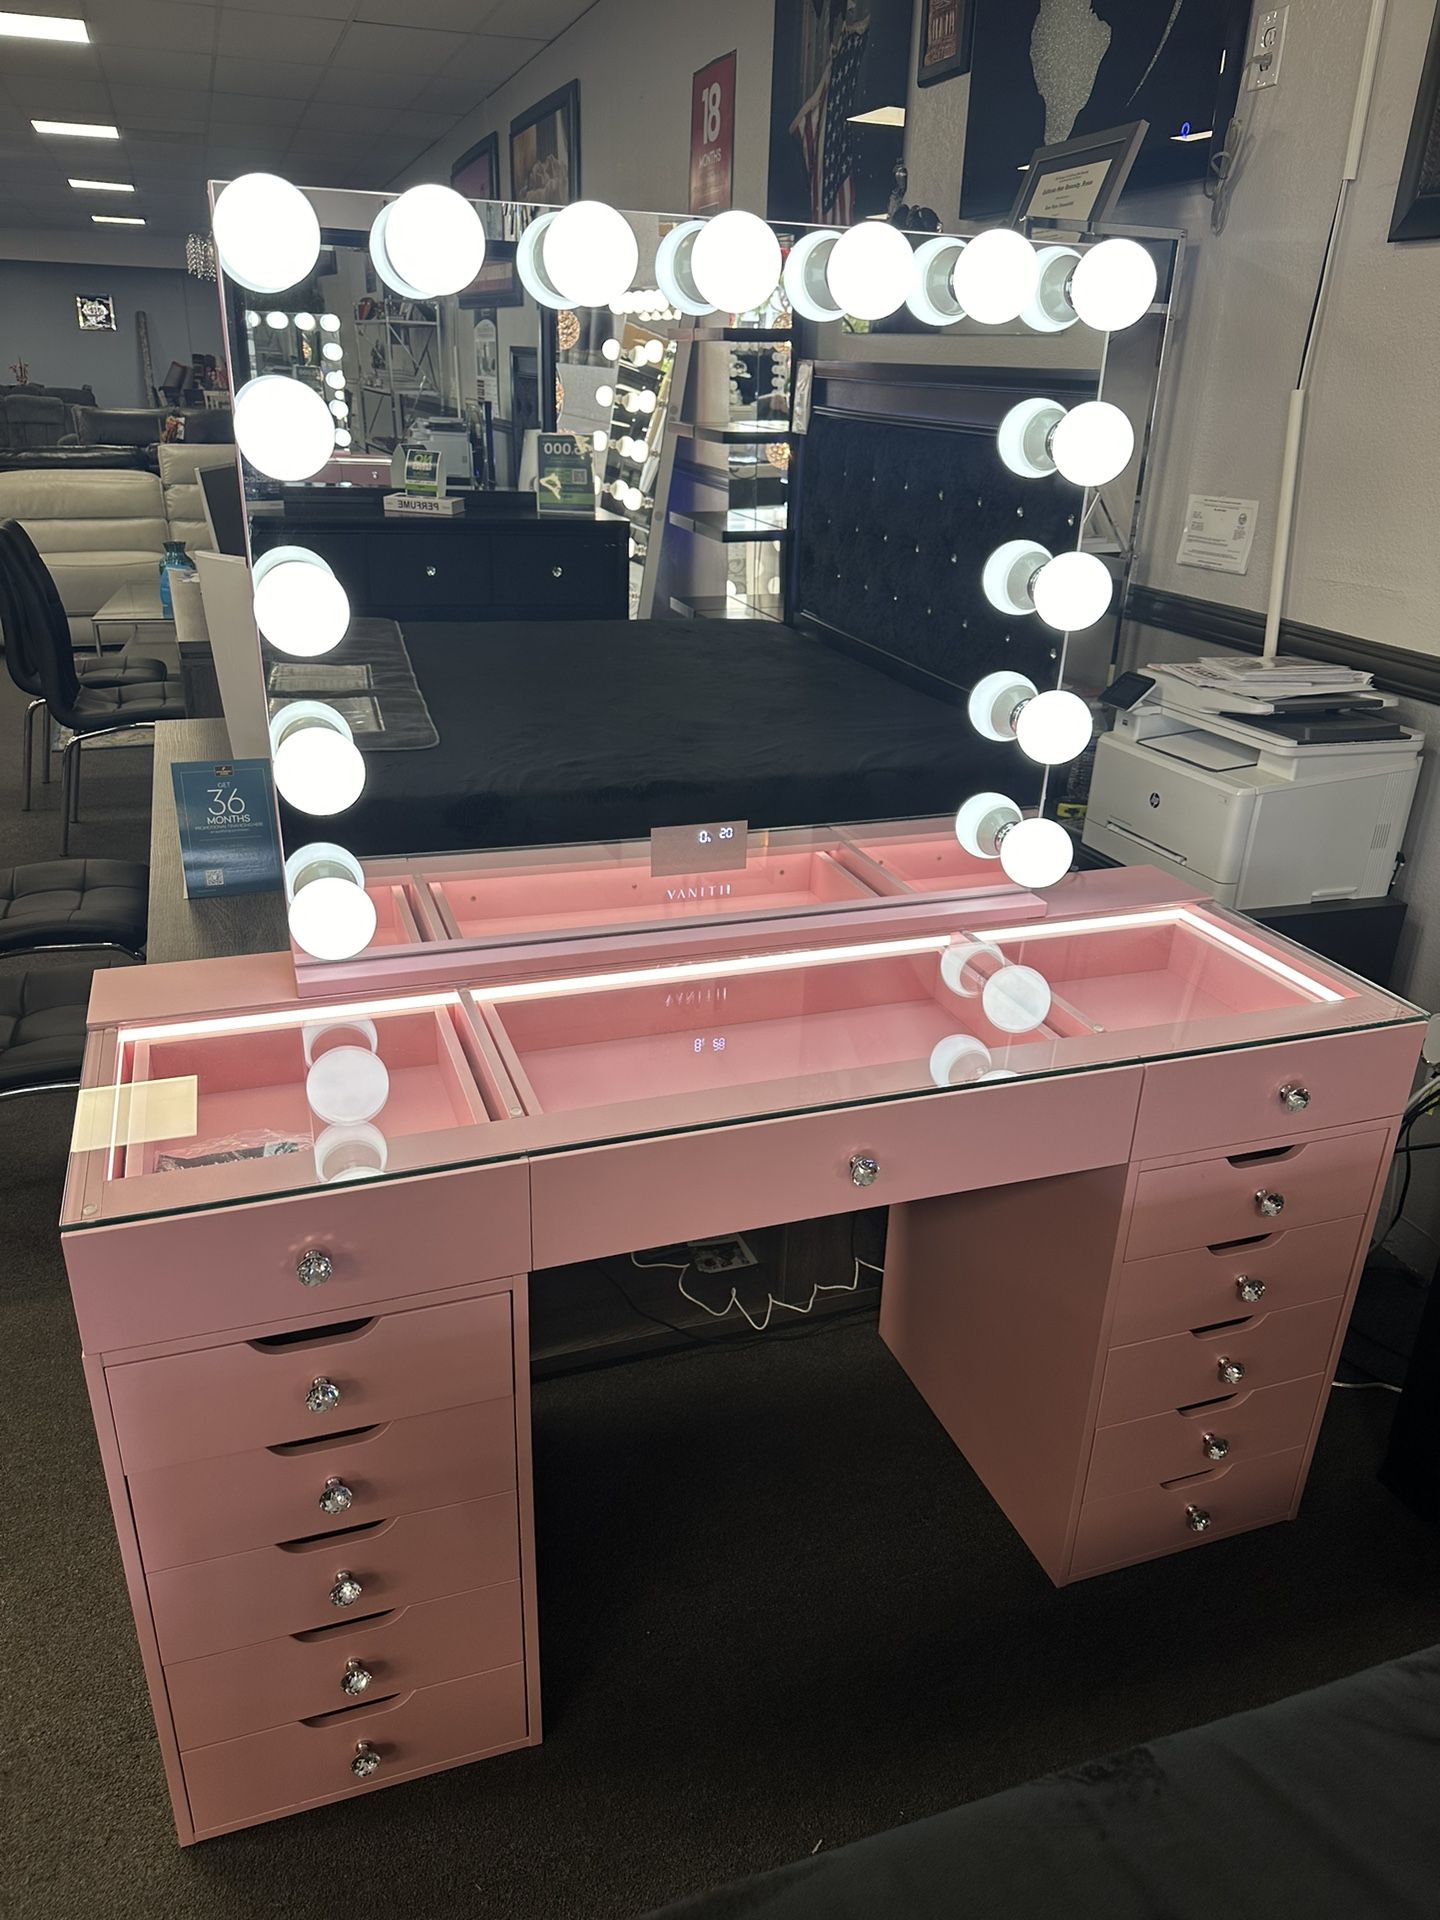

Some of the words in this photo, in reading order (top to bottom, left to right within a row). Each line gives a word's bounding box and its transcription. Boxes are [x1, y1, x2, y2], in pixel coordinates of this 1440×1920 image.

[702, 82, 721, 145] 18
[699, 148, 722, 169] MONTHS
[206, 787, 246, 816] 36
[206, 813, 251, 825] MONTHS
